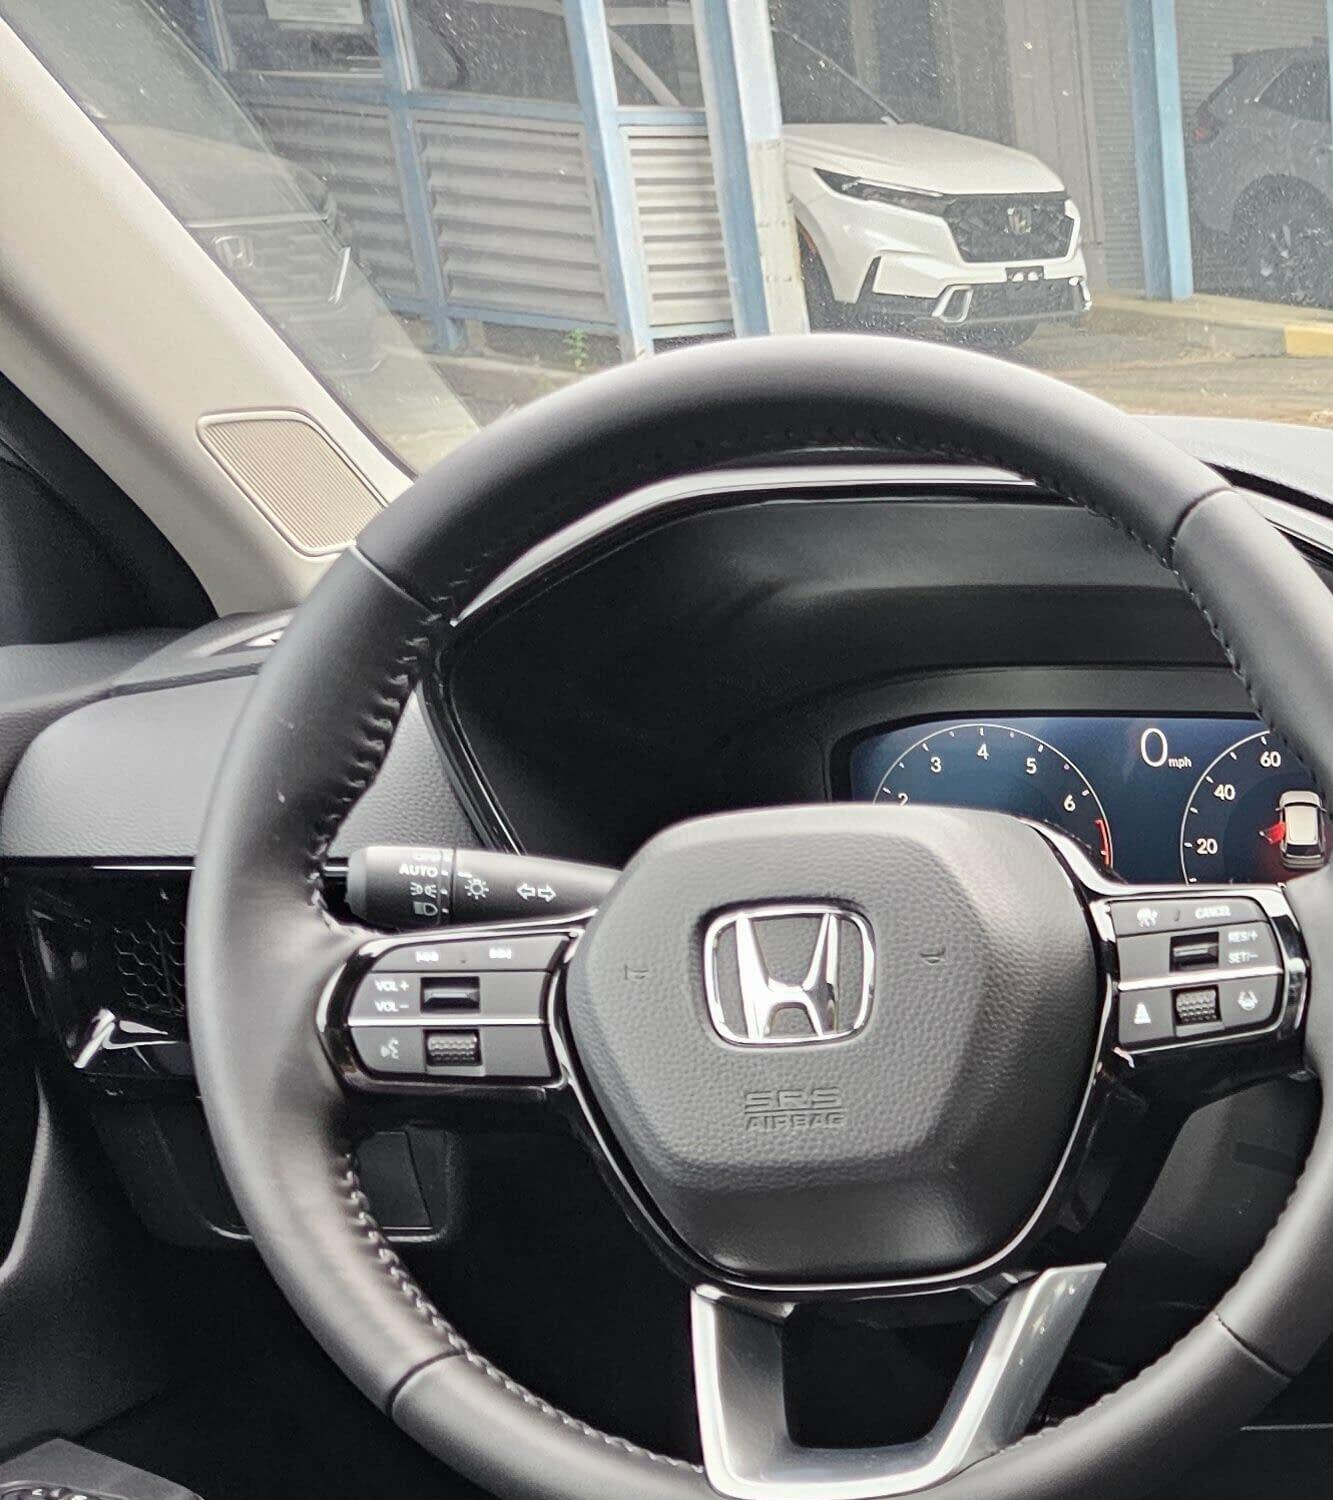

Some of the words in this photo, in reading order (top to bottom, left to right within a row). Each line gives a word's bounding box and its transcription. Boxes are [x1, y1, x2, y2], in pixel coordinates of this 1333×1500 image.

[976, 743, 990, 761] 4
[1140, 727, 1168, 767] 0
[1168, 756, 1192, 768] mph
[930, 756, 942, 773] 3
[1025, 757, 1038, 774] 5
[1259, 750, 1282, 767] 60
[1213, 784, 1236, 800] 40
[1063, 794, 1076, 812] 6
[1196, 838, 1218, 854] 20
[399, 863, 438, 878] AUTO
[374, 979, 399, 992] VOL
[374, 999, 399, 1012] VOL
[743, 1086, 843, 1108] SRS
[745, 1112, 845, 1131] AIRBAG
